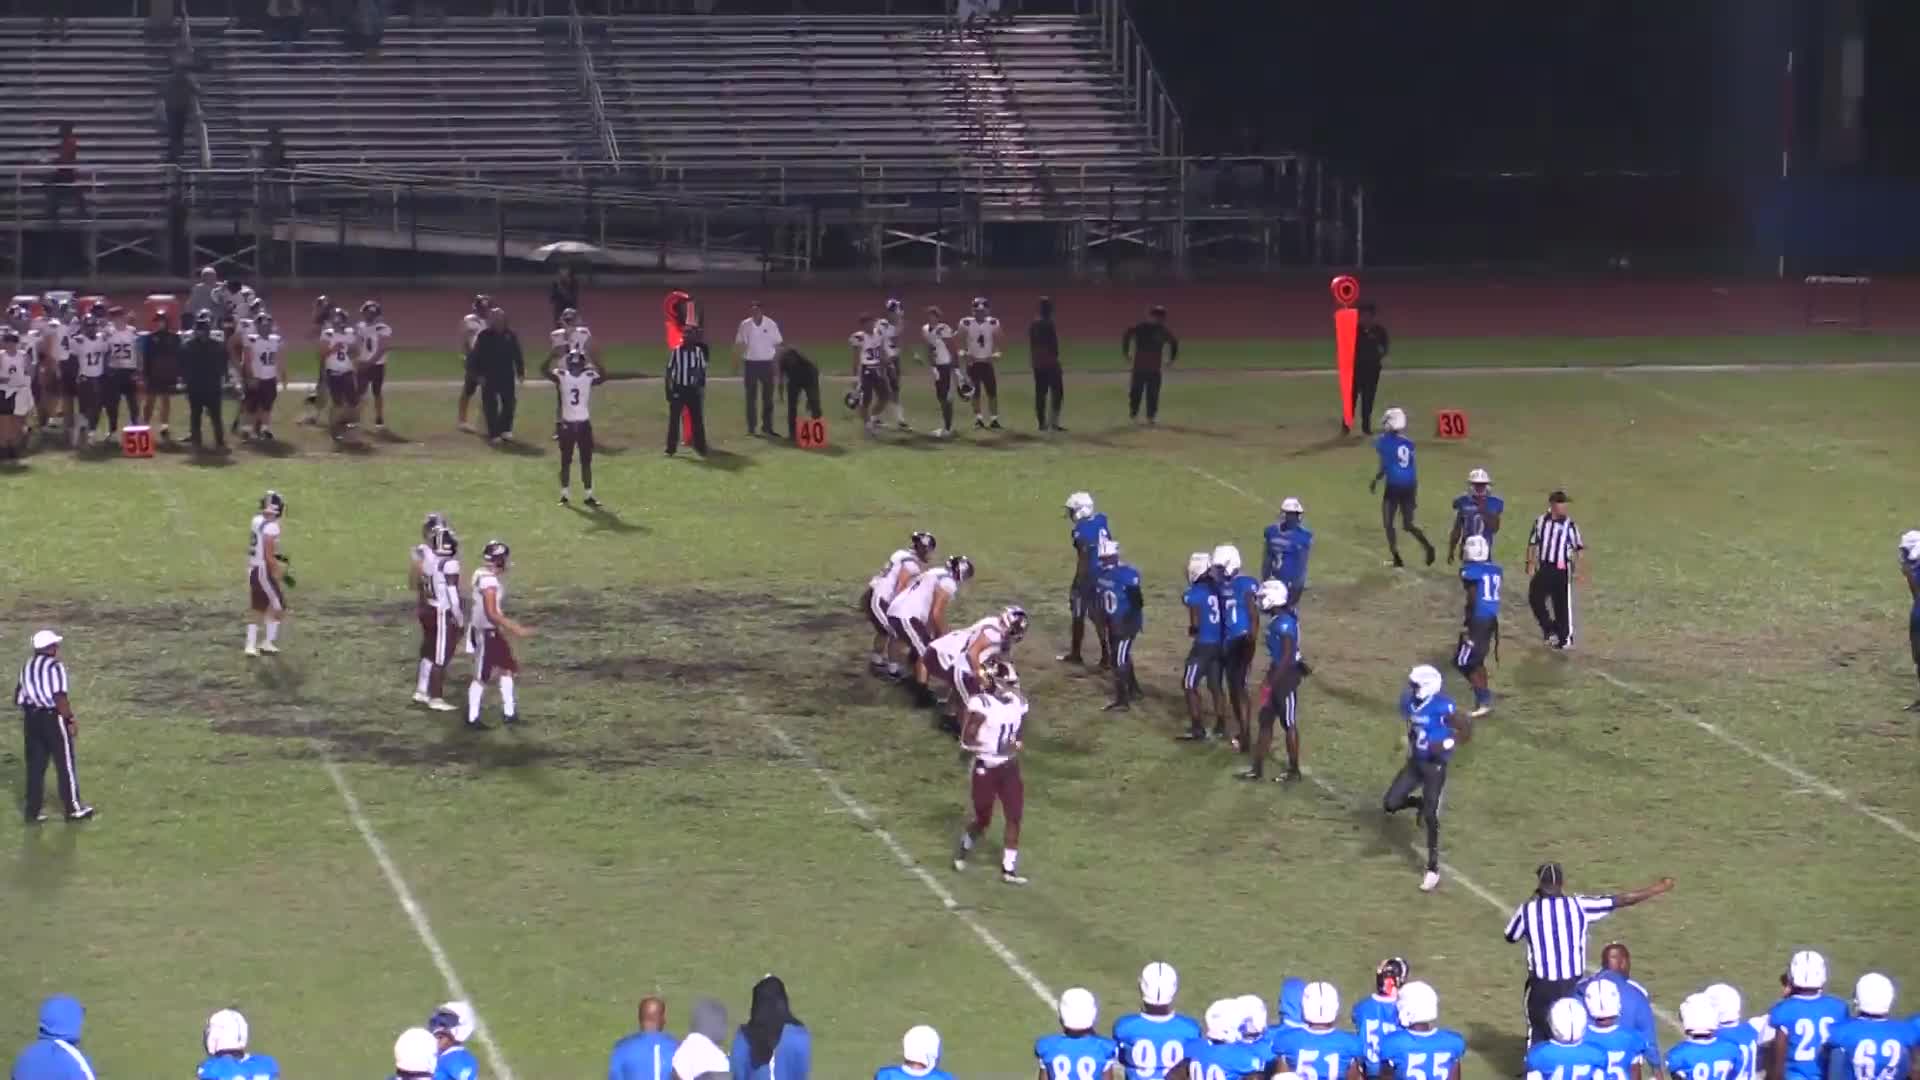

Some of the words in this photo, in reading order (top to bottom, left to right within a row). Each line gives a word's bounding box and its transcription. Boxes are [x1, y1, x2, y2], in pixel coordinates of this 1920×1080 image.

[570, 388, 580, 405] 3
[800, 421, 824, 445] 40
[1441, 413, 1465, 436] 30
[127, 431, 150, 454] 50
[1397, 444, 1410, 468] 9
[1406, 1052, 1452, 1080] 55
